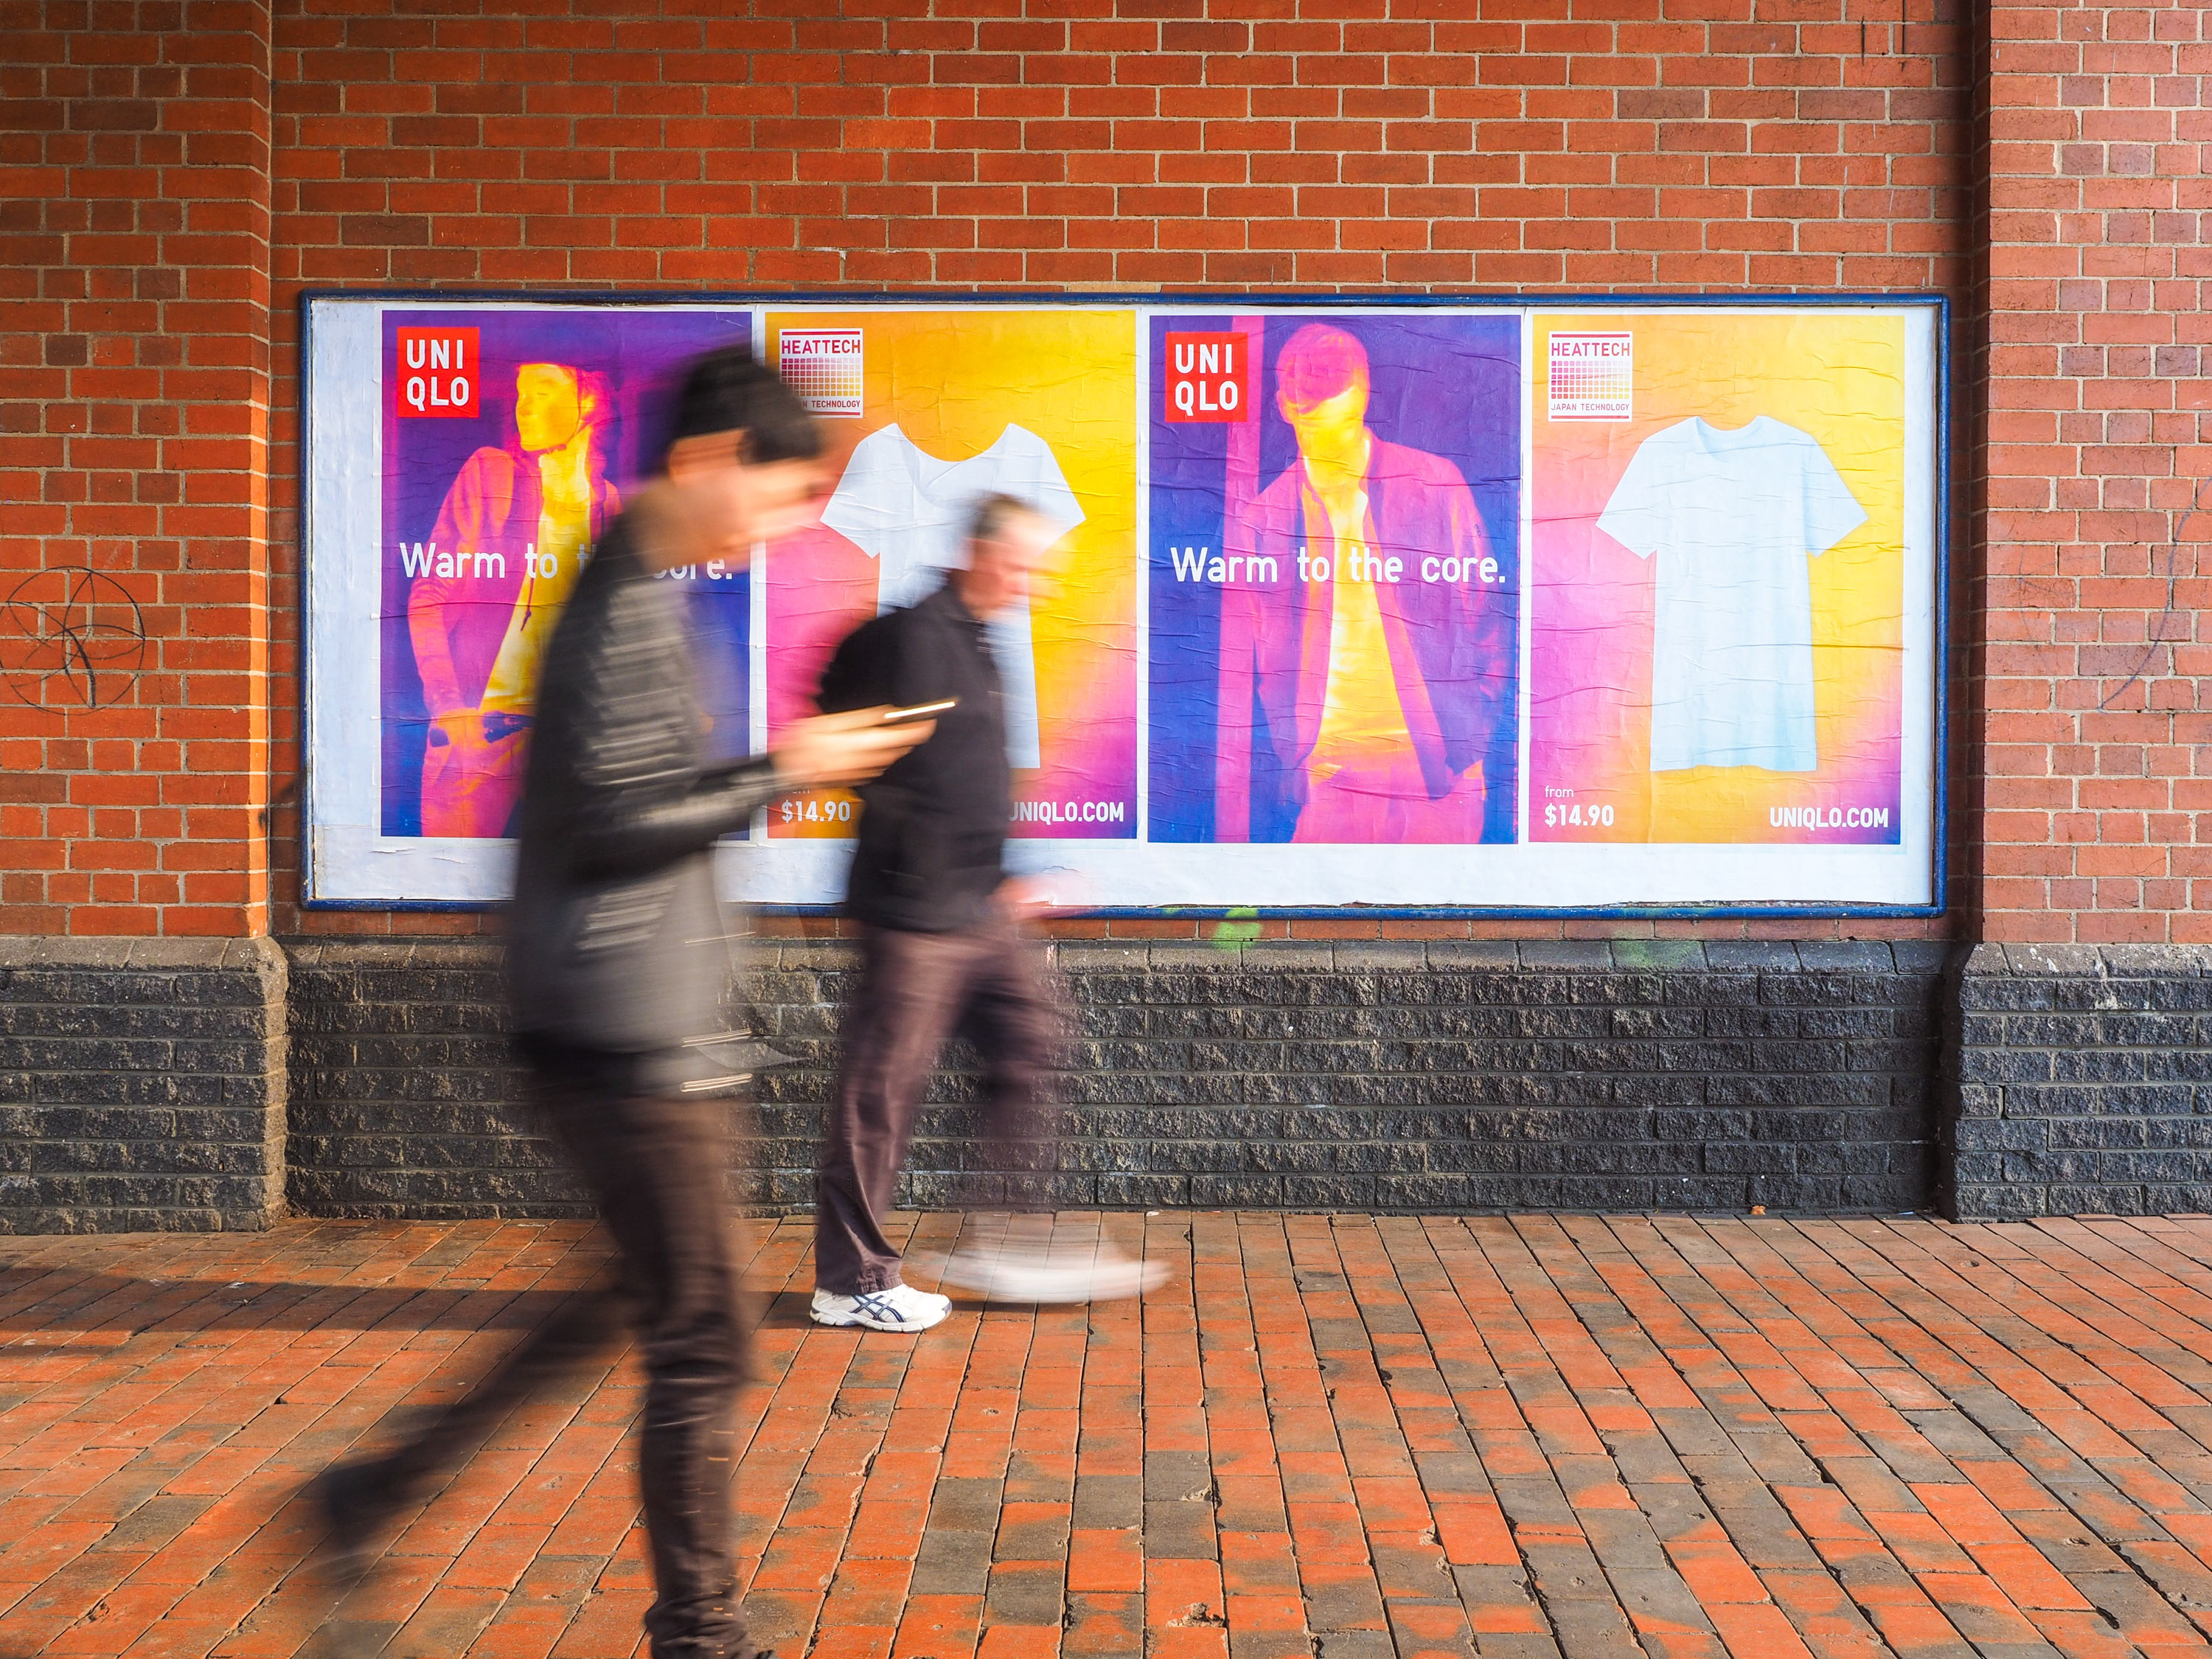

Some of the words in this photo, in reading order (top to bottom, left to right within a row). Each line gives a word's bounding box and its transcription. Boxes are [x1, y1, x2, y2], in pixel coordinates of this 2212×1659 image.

[406, 339, 464, 369] UNI
[782, 340, 860, 354] HEATTECH
[1175, 344, 1232, 374] UNI
[1551, 343, 1630, 356] HEATTECH
[406, 376, 470, 411] QLO
[1175, 380, 1239, 416] QLO
[399, 542, 506, 579] Warm
[525, 543, 558, 579] to
[1170, 546, 1278, 582] Warm
[1297, 546, 1330, 582] to
[1349, 546, 1404, 582] the
[1422, 556, 1506, 583] core.
[1545, 785, 1574, 798] from
[782, 799, 851, 824] $14.90
[1545, 802, 1614, 827] $14.90
[1770, 807, 1889, 831] UNIQLO.COM
